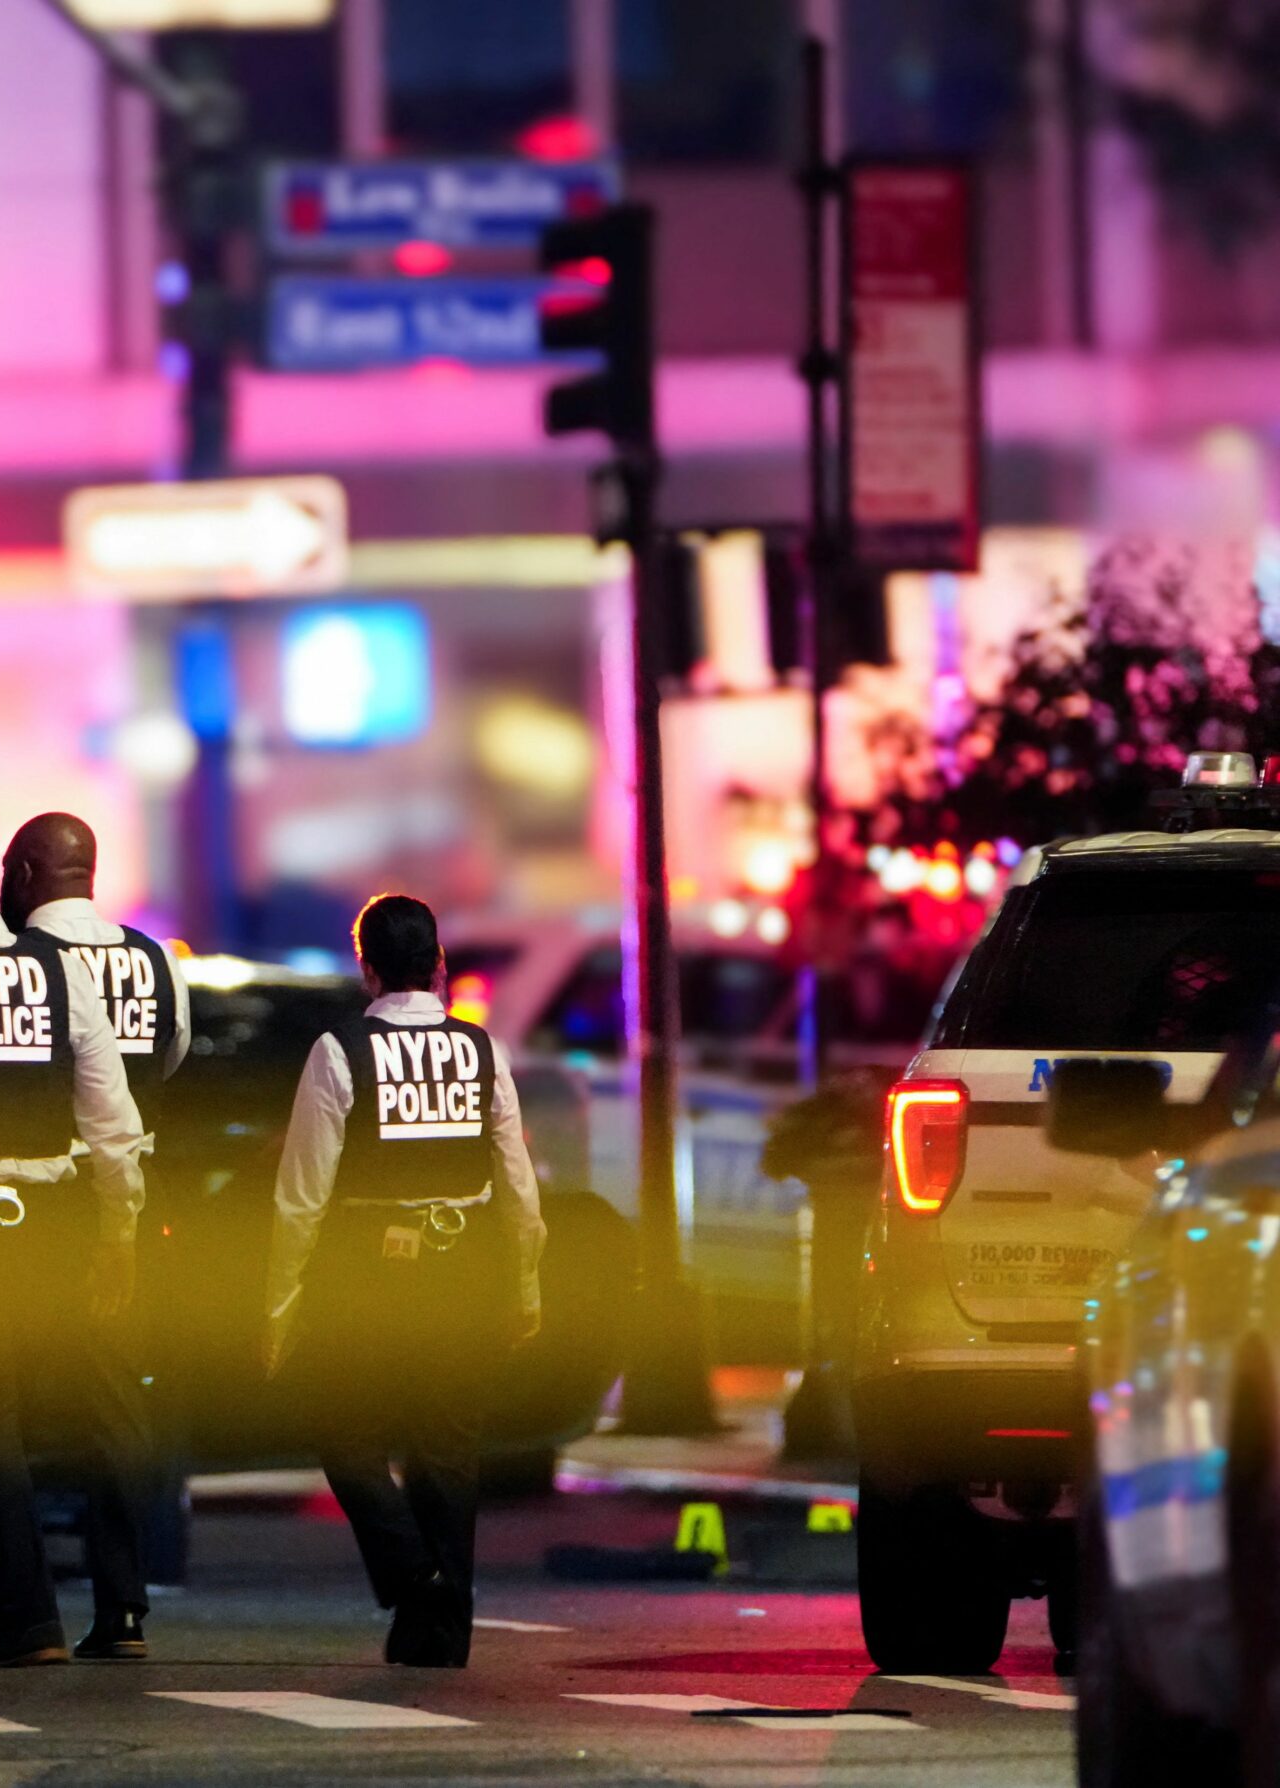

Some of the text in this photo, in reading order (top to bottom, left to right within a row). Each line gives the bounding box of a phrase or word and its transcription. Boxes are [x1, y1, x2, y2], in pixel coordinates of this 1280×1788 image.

[70, 947, 155, 998] YPD
[369, 1031, 479, 1083] NYPD
[377, 1082, 482, 1123] POLICE
